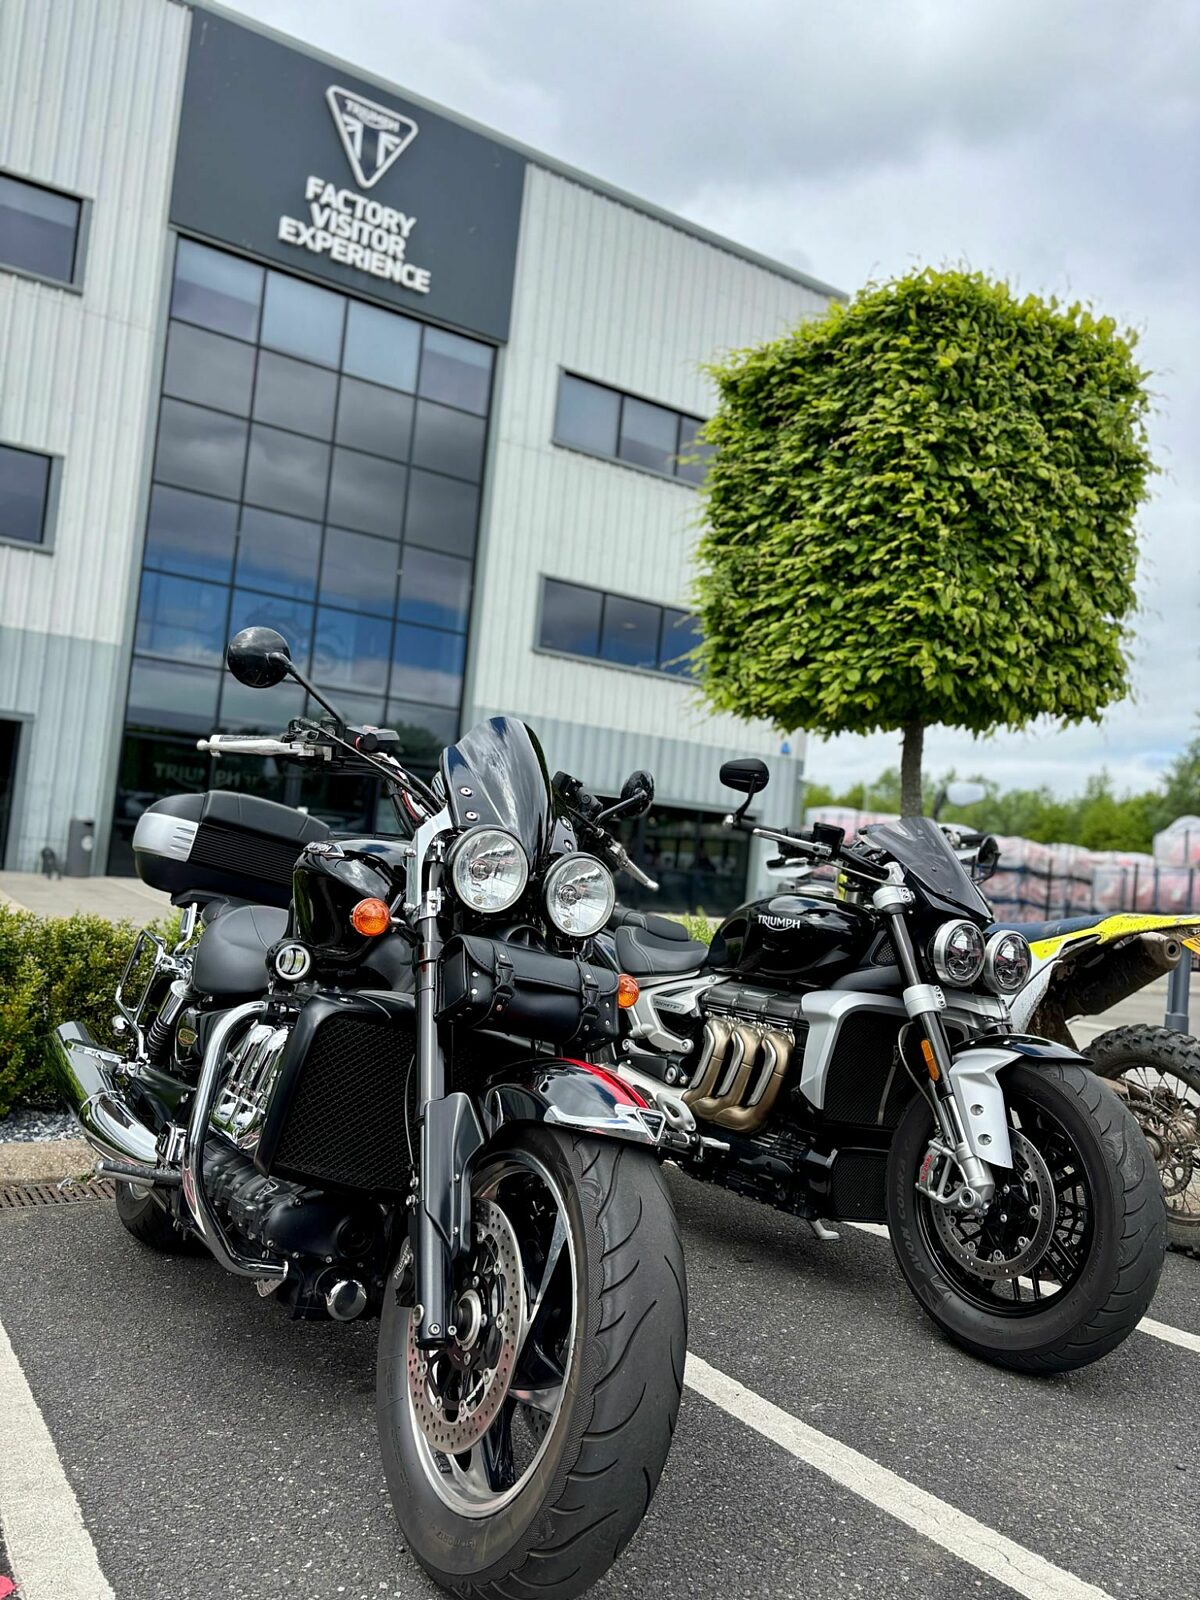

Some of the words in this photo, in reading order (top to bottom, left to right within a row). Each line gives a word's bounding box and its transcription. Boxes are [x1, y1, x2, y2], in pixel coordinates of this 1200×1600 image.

[305, 175, 417, 238] FACTORY
[310, 202, 406, 259] VISITOR
[278, 215, 431, 293] EXPERIENCE
[757, 914, 801, 930] TRIUMPH
[896, 1159, 907, 1221] COBRA
[901, 1229, 927, 1274] AVON
